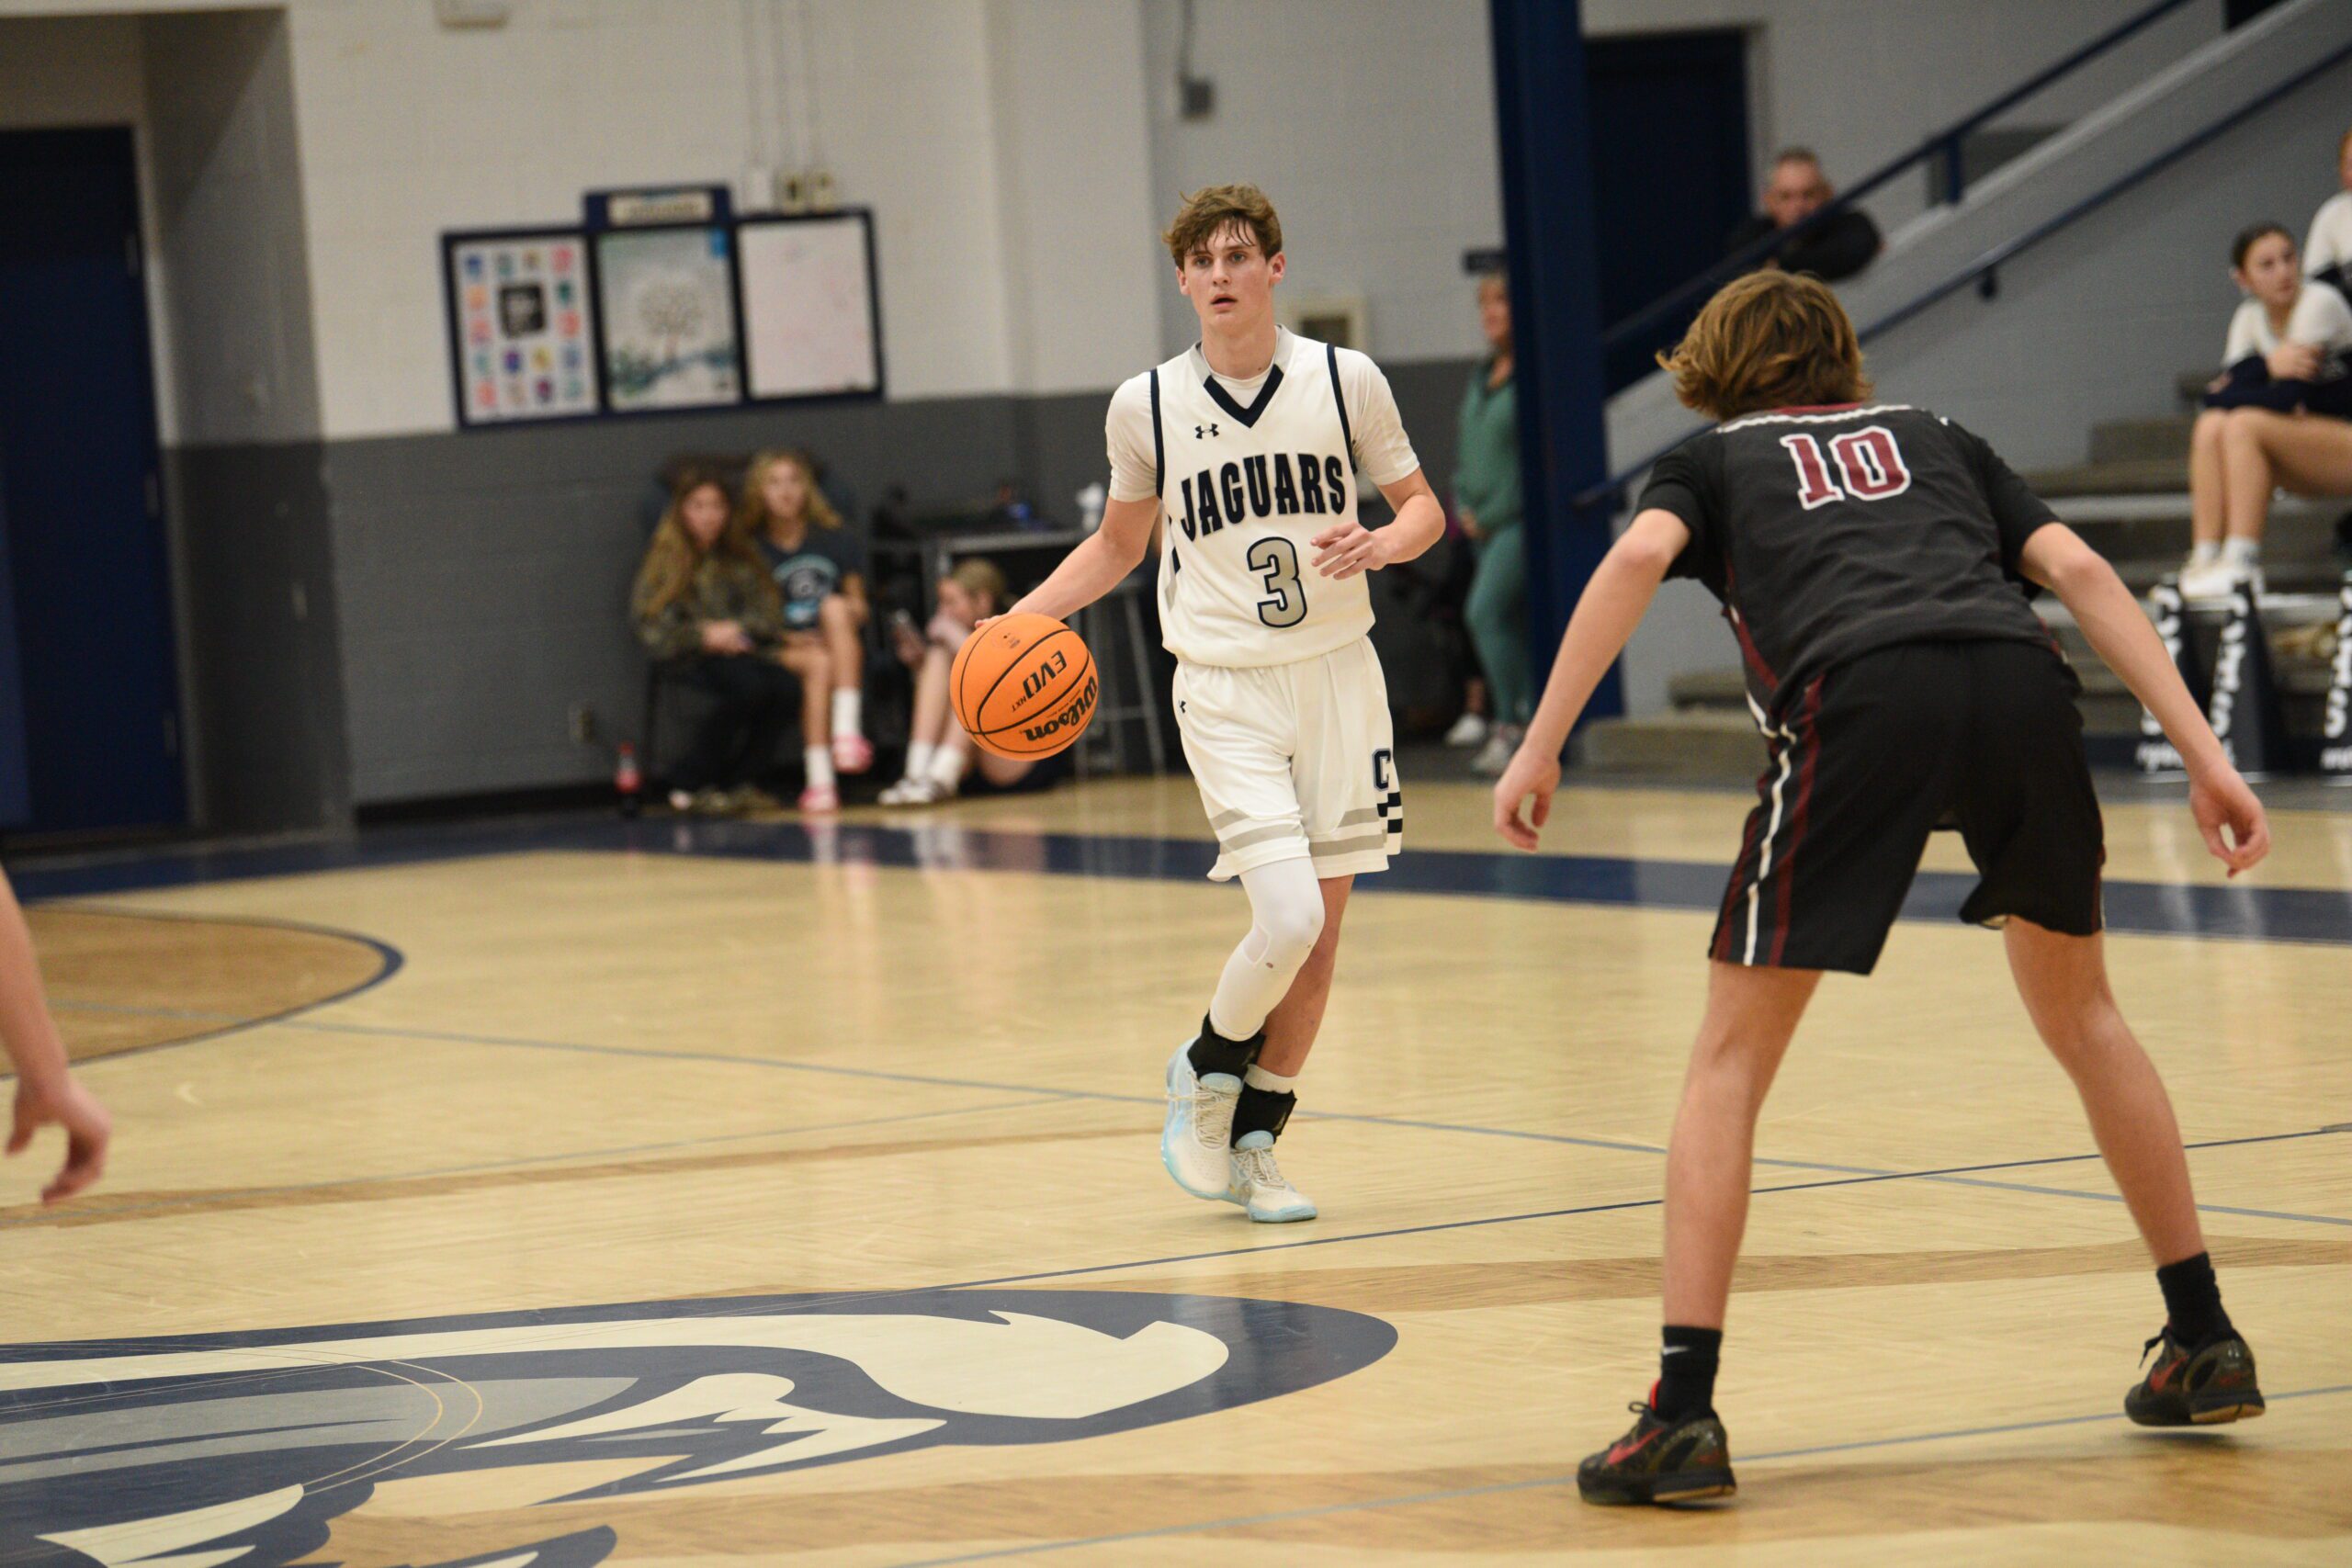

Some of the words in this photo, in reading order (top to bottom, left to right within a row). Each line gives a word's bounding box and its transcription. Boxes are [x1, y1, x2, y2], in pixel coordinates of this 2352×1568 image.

[1181, 453, 1346, 542] JAGUARS
[1780, 425, 1911, 510] 10
[1247, 536, 1307, 627] 3
[1023, 675, 1097, 741] Wilson
[1372, 748, 1392, 792] C
